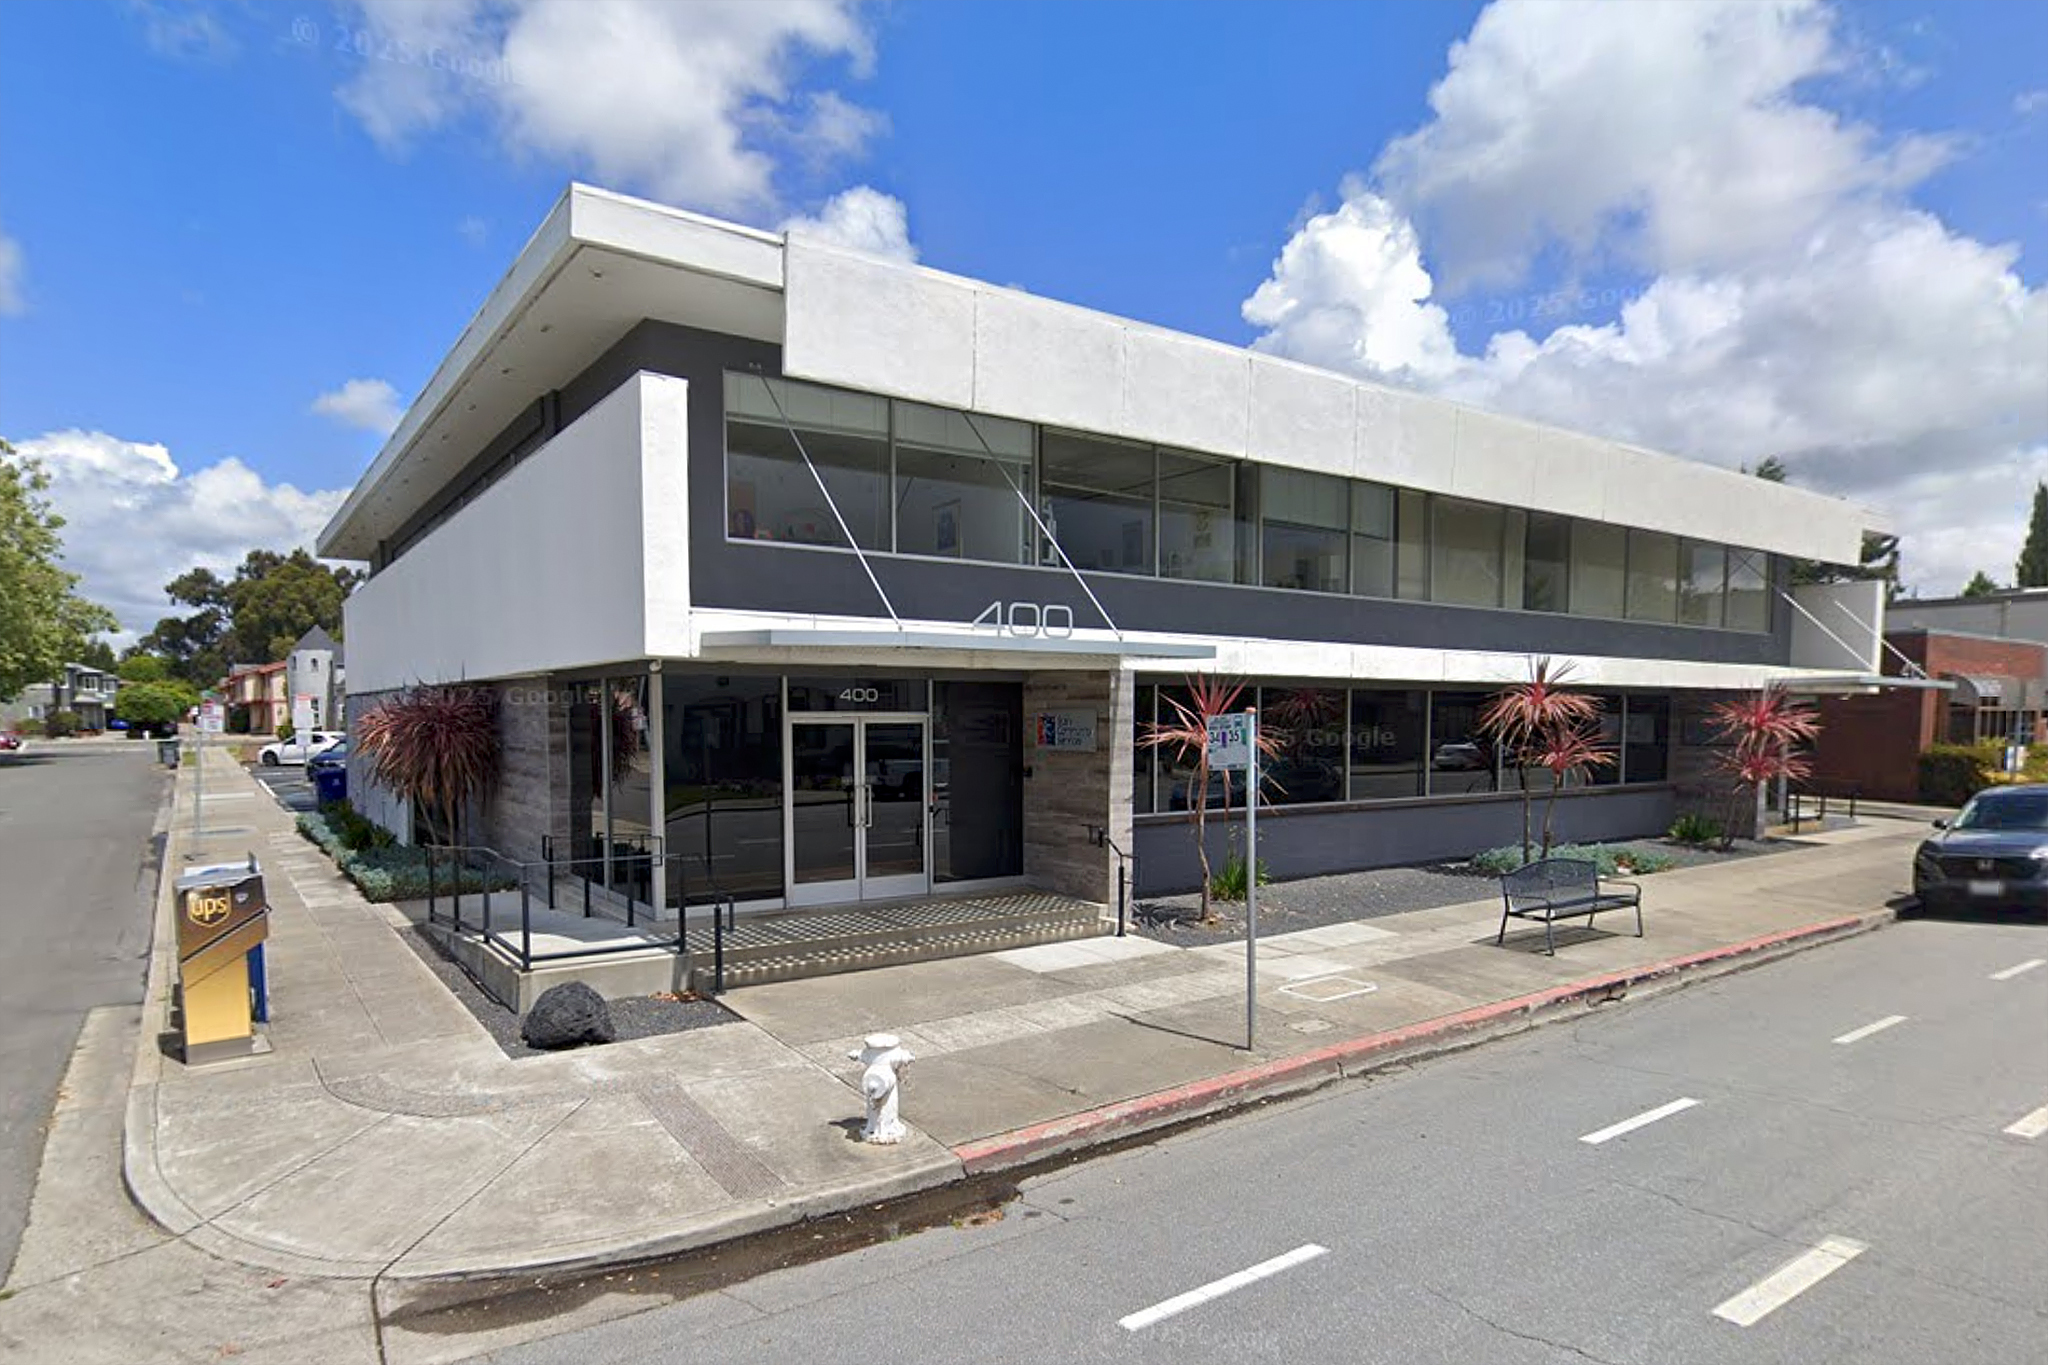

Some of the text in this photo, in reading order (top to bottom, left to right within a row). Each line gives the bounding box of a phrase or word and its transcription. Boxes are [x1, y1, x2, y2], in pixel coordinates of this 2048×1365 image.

[972, 601, 1073, 639] 400
[839, 688, 879, 702] 400
[1208, 729, 1240, 744] 34 35
[191, 897, 227, 921] ups
